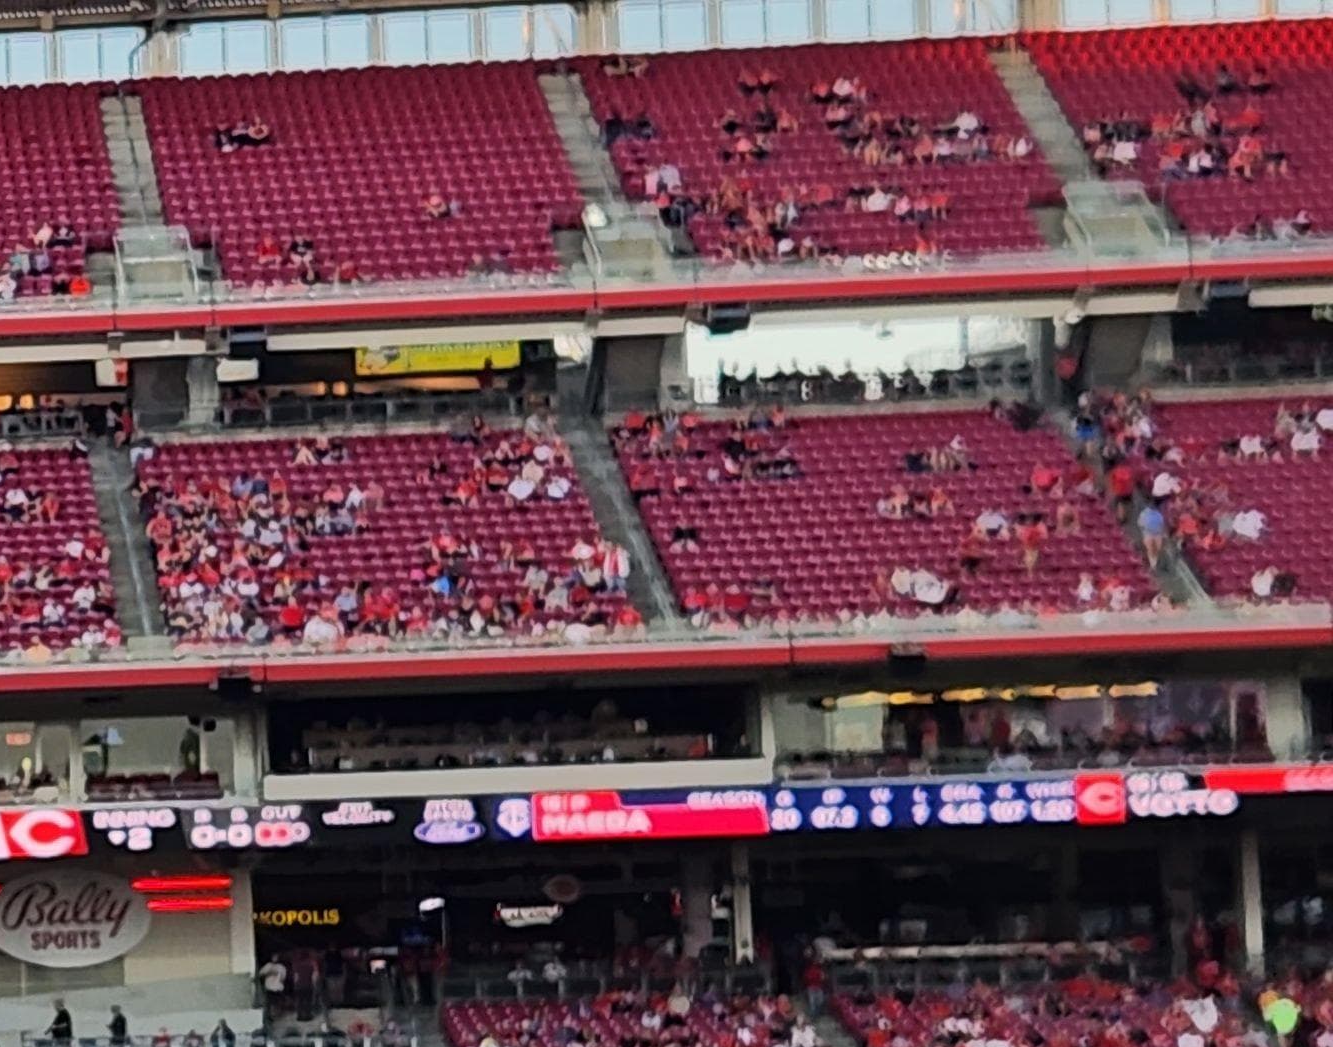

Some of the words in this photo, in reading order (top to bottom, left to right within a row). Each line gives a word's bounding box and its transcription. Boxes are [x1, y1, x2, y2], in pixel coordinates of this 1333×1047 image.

[541, 809, 652, 835] MAEDA
[1, 880, 131, 938] Bally
[253, 908, 341, 926] KOPOLIS
[30, 929, 102, 950] SPORTS
